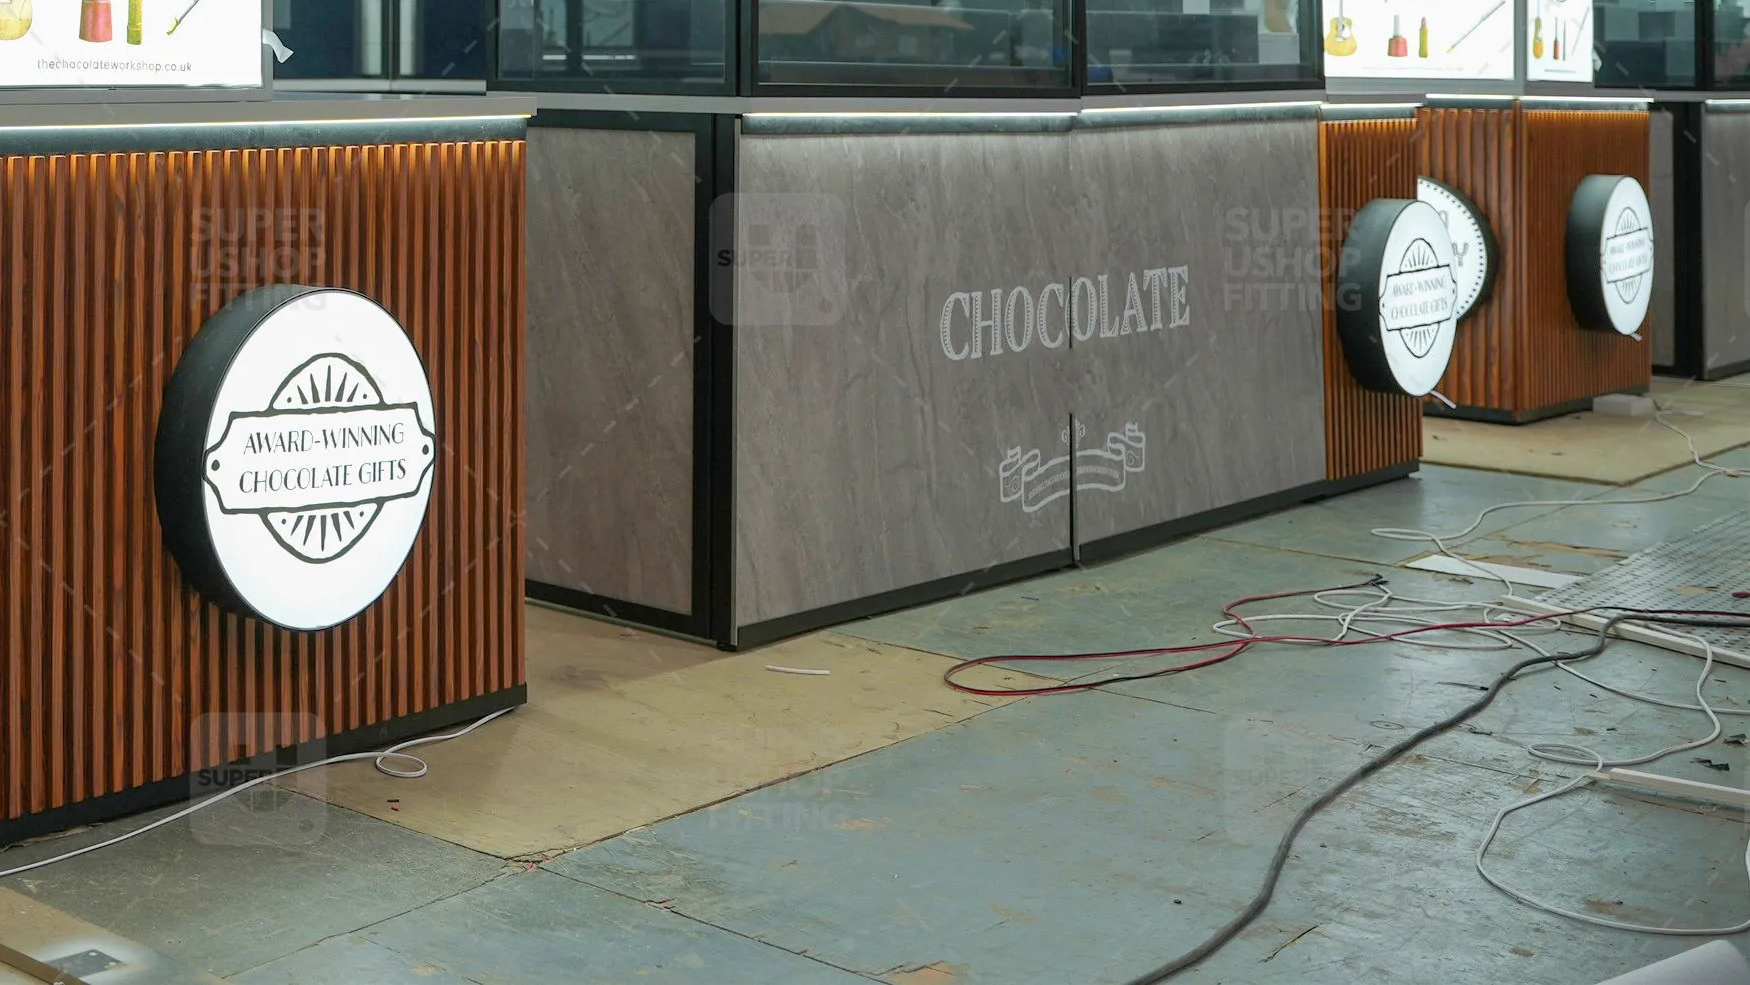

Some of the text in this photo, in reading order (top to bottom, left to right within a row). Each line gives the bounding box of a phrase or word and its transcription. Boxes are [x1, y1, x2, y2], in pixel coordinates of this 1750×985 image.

[37, 59, 192, 74] thechocolateworkshop.co.uk
[940, 265, 1190, 362] CHOCOLATE
[244, 422, 404, 455] AWARD-WINNING
[239, 458, 407, 494] CHOCOLATE GIFTS
